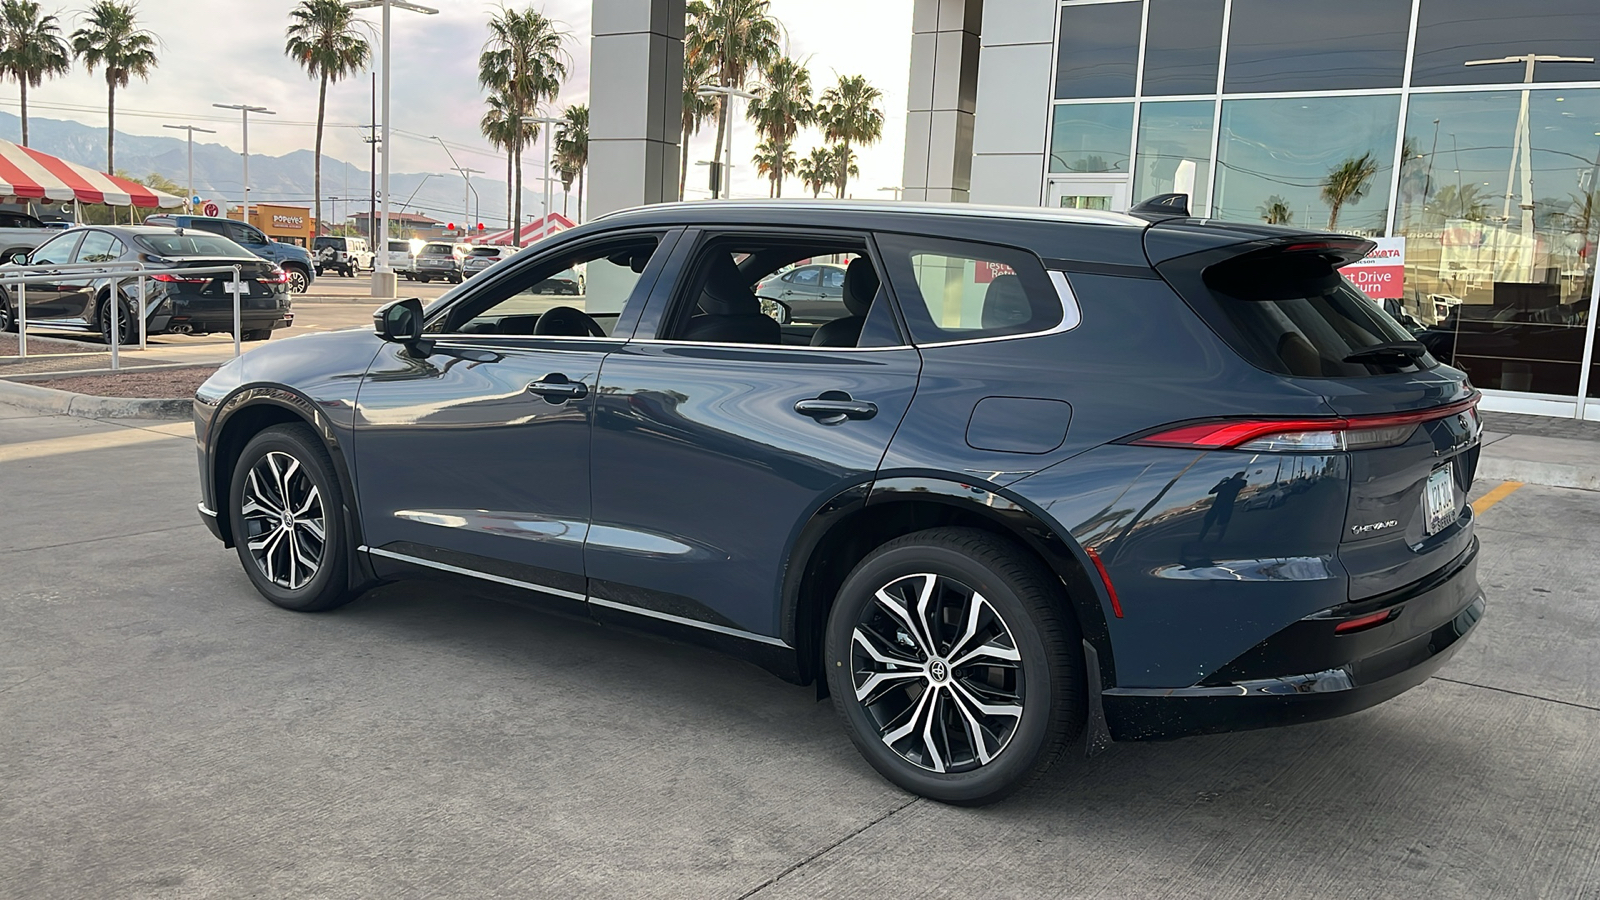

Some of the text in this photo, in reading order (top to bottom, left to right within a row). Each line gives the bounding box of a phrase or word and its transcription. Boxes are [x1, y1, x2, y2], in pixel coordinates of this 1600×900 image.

[1368, 250, 1400, 258] OYOTA
[1358, 272, 1392, 283] Drive
[1356, 283, 1381, 292] urn
